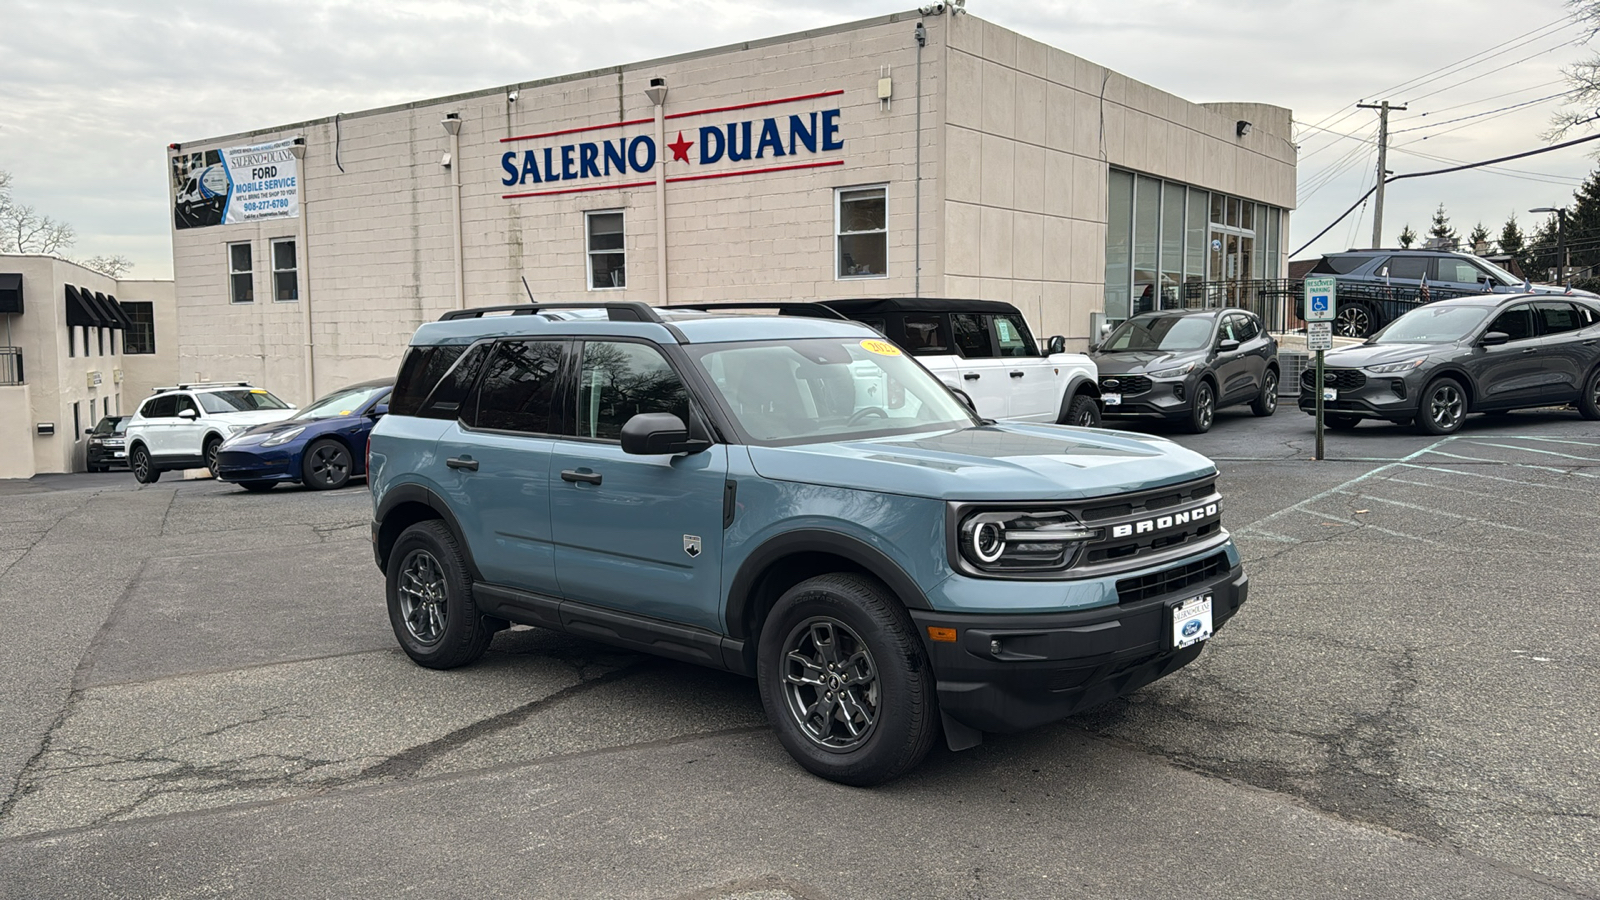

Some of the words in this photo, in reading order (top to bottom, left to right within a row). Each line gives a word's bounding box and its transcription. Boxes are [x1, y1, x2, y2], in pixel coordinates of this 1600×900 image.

[501, 135, 657, 187] SALERNO
[698, 108, 845, 165] DUANE
[252, 166, 278, 180] FORD
[236, 181, 263, 194] MOBILE
[264, 177, 296, 190] SERVICE
[244, 198, 289, 212] 908-277-6780
[867, 342, 896, 353] 2022
[1112, 503, 1217, 538] BRONCO
